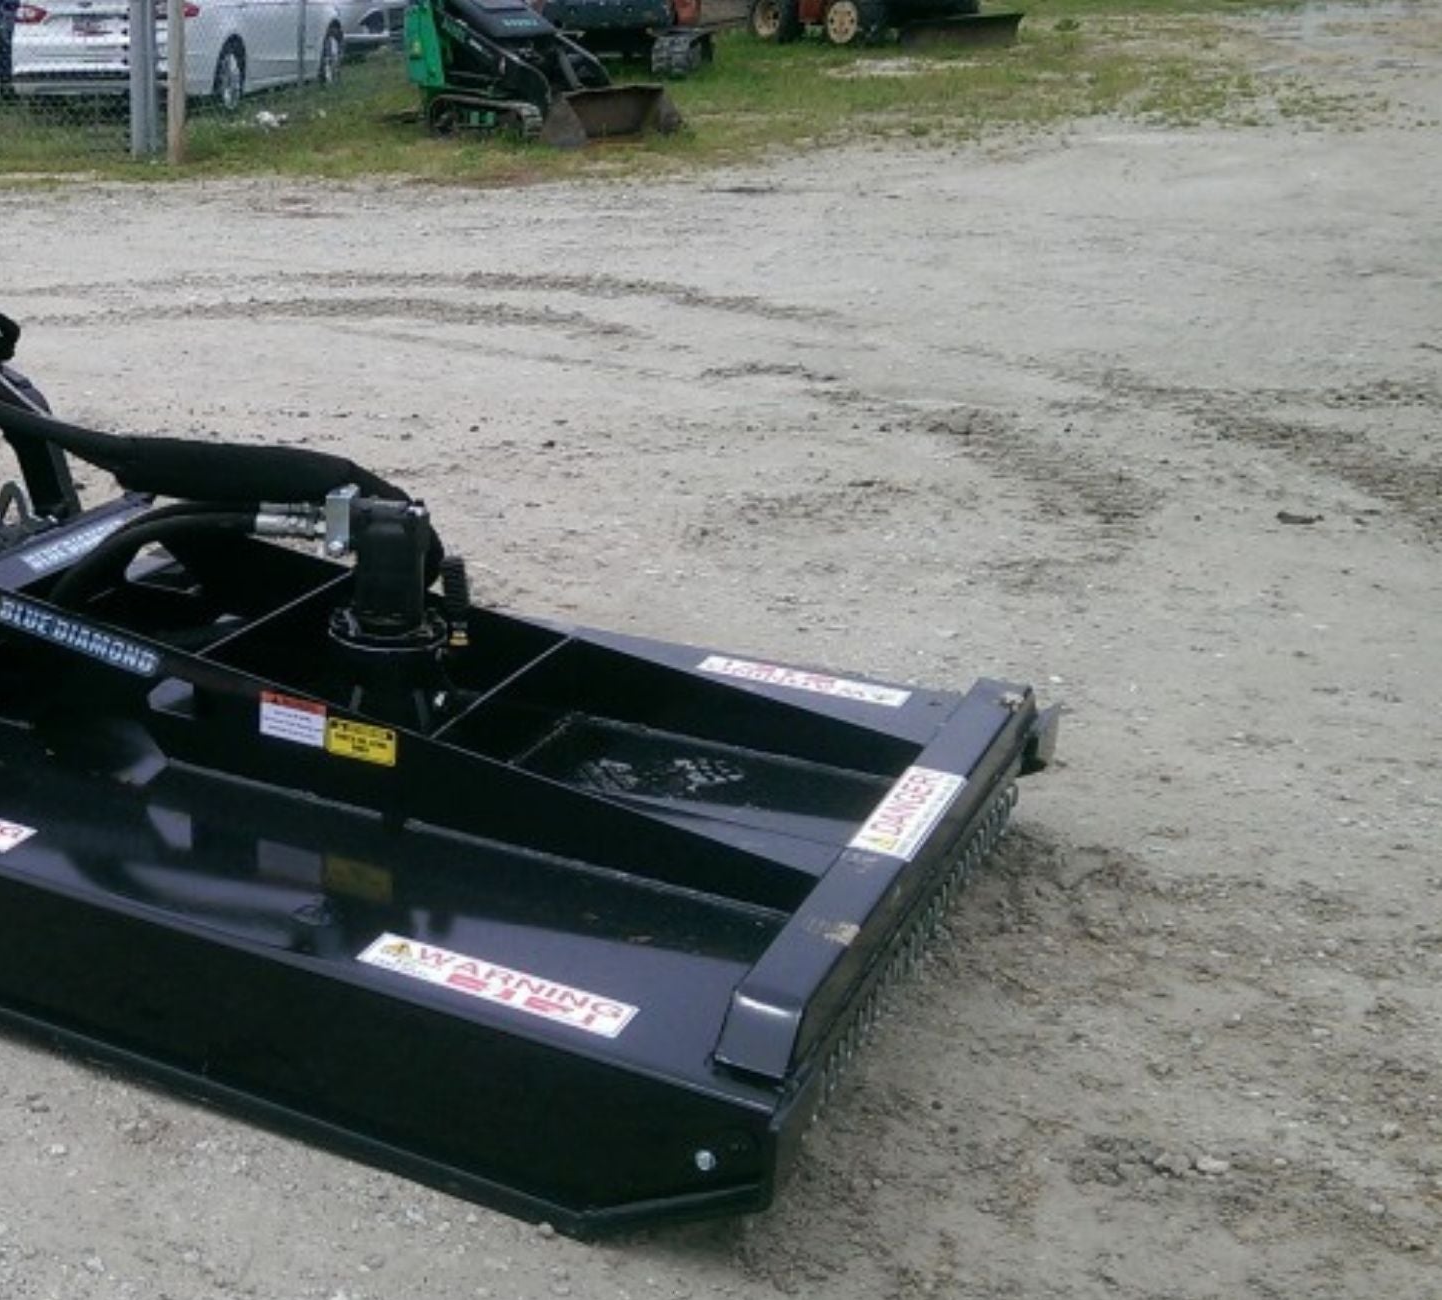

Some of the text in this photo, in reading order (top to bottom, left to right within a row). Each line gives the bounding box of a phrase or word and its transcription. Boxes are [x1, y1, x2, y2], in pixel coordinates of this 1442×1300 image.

[0, 599, 159, 673] BLUE DIAMOND
[418, 945, 625, 1020] WARNING
